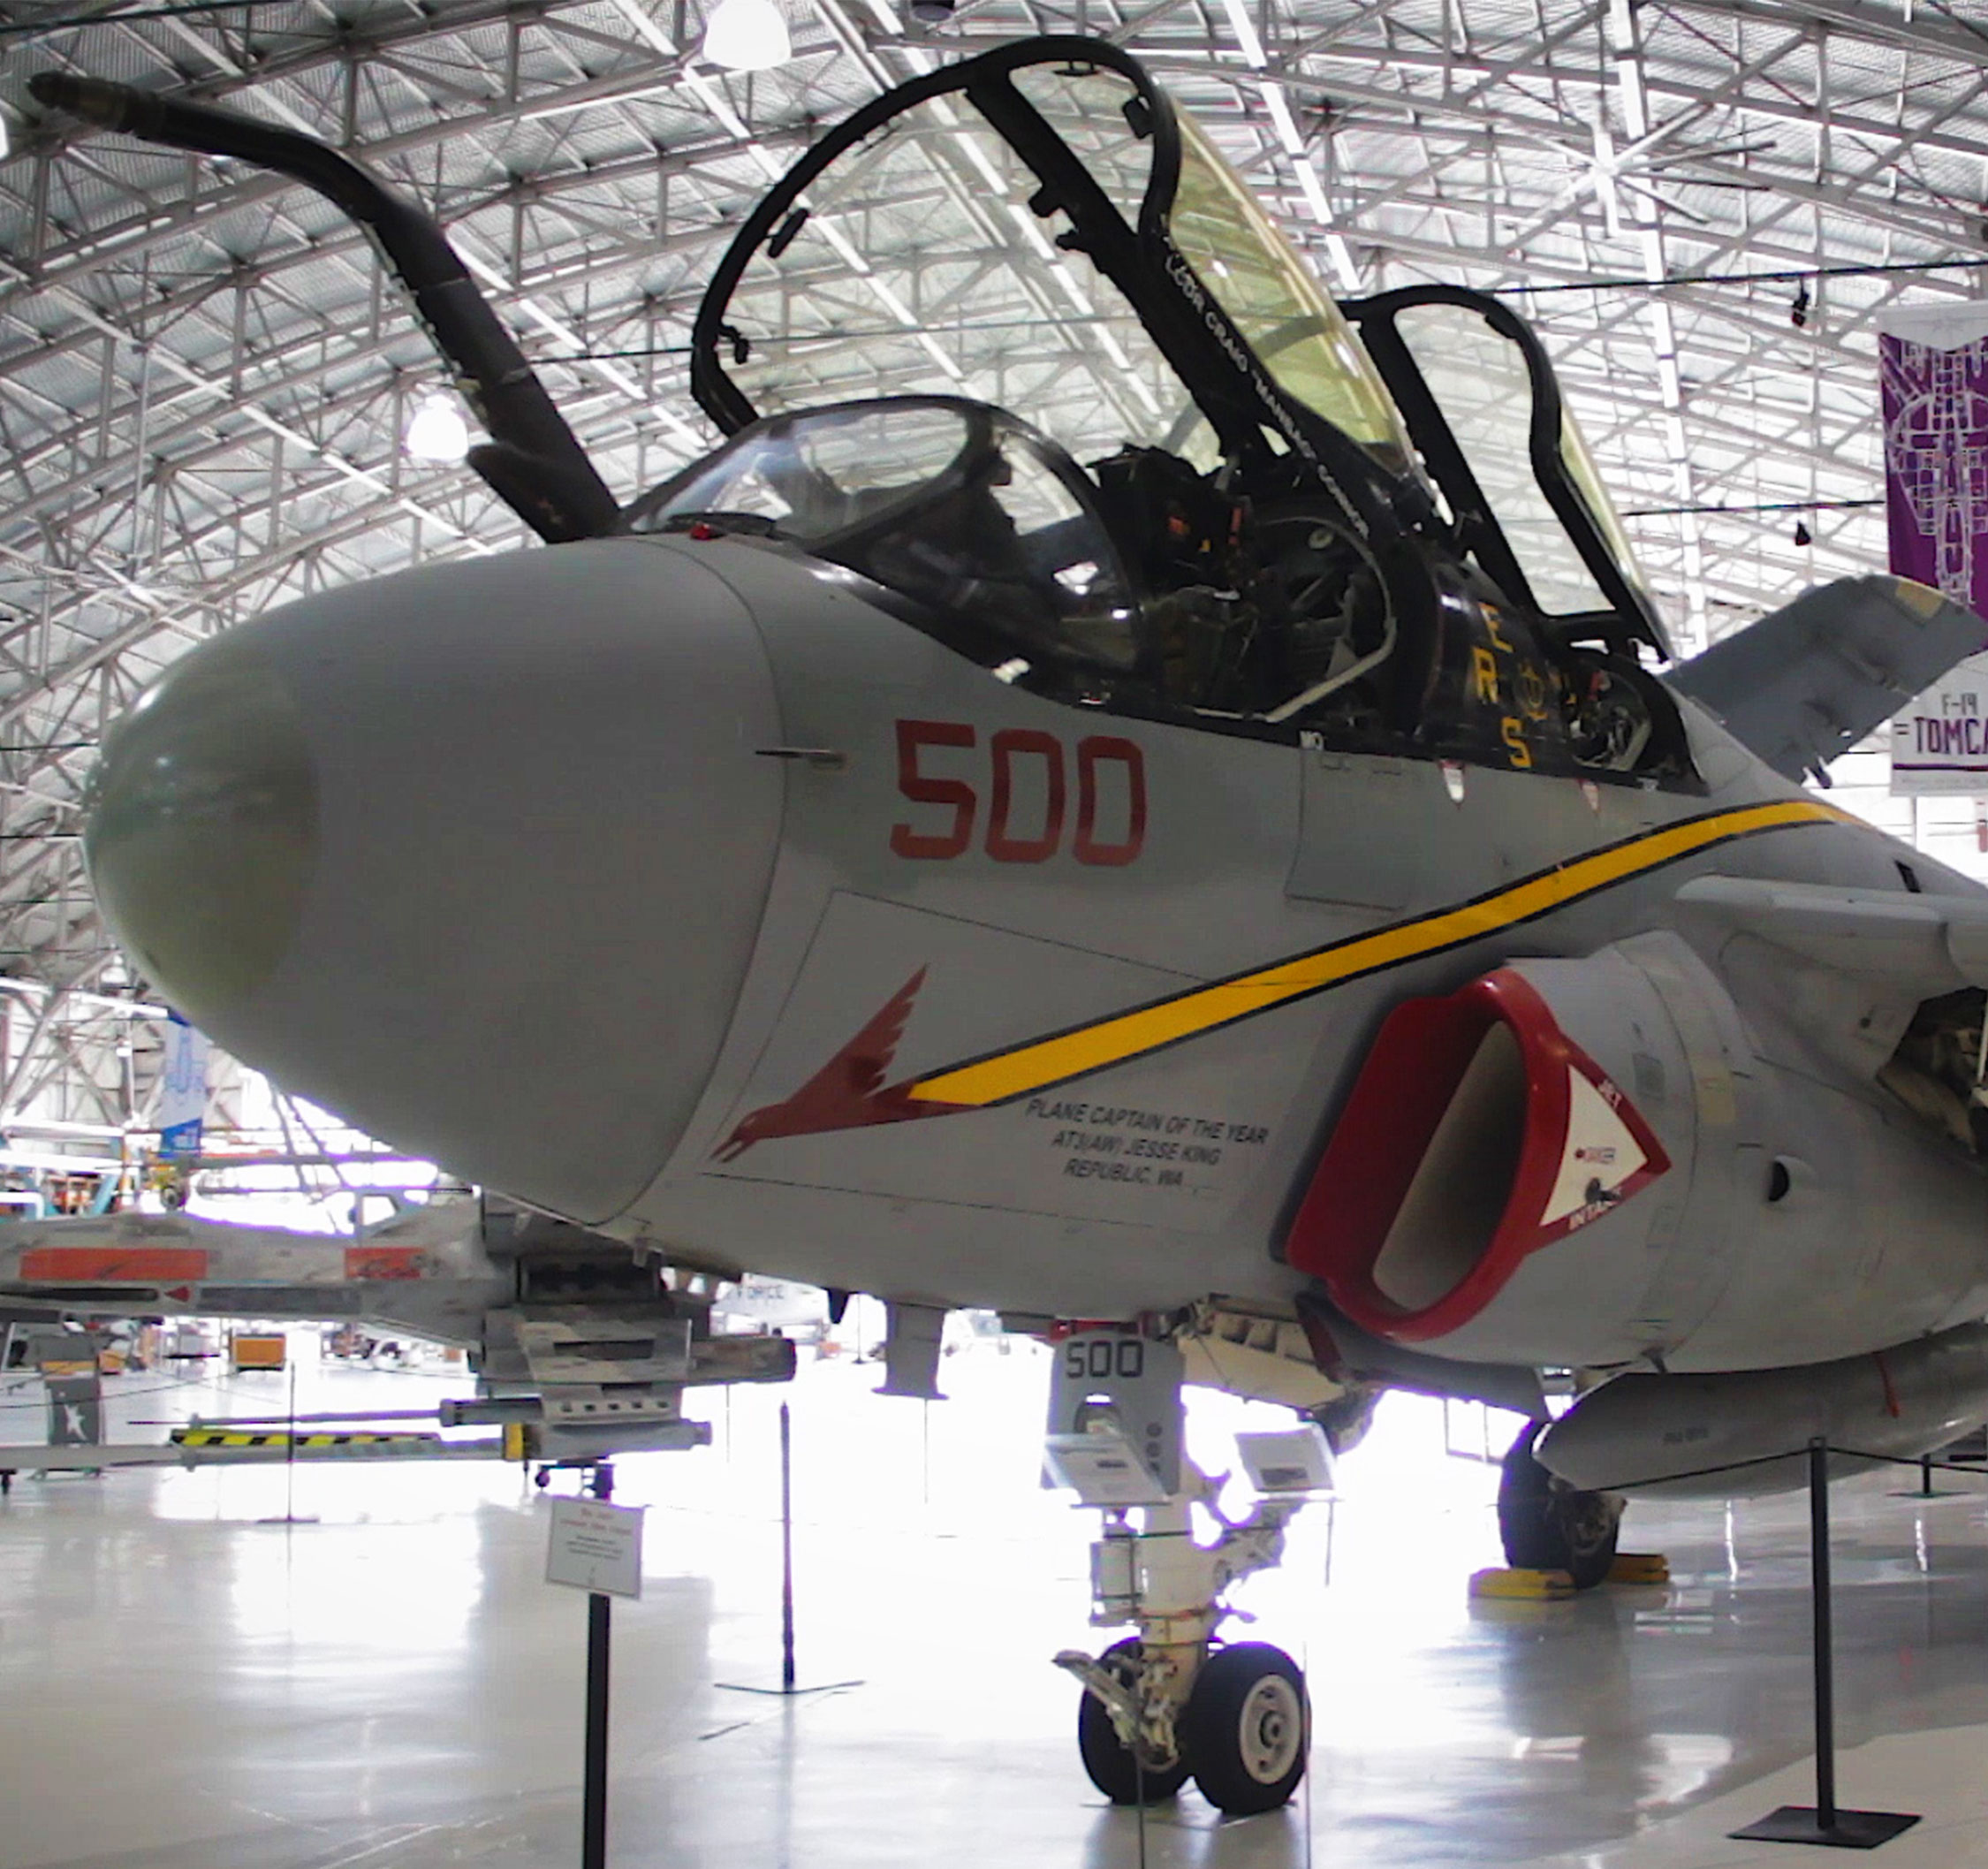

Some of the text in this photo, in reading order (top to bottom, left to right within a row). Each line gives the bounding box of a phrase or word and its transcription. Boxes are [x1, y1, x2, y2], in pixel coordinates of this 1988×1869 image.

[890, 718, 1147, 868] 500
[1026, 1098, 1270, 1145] PLANE CAPTAIN OF THE YEAR
[1124, 1138, 1180, 1160] JESSE
[1180, 1147, 1223, 1166] KING
[1066, 1339, 1143, 1379] 500
